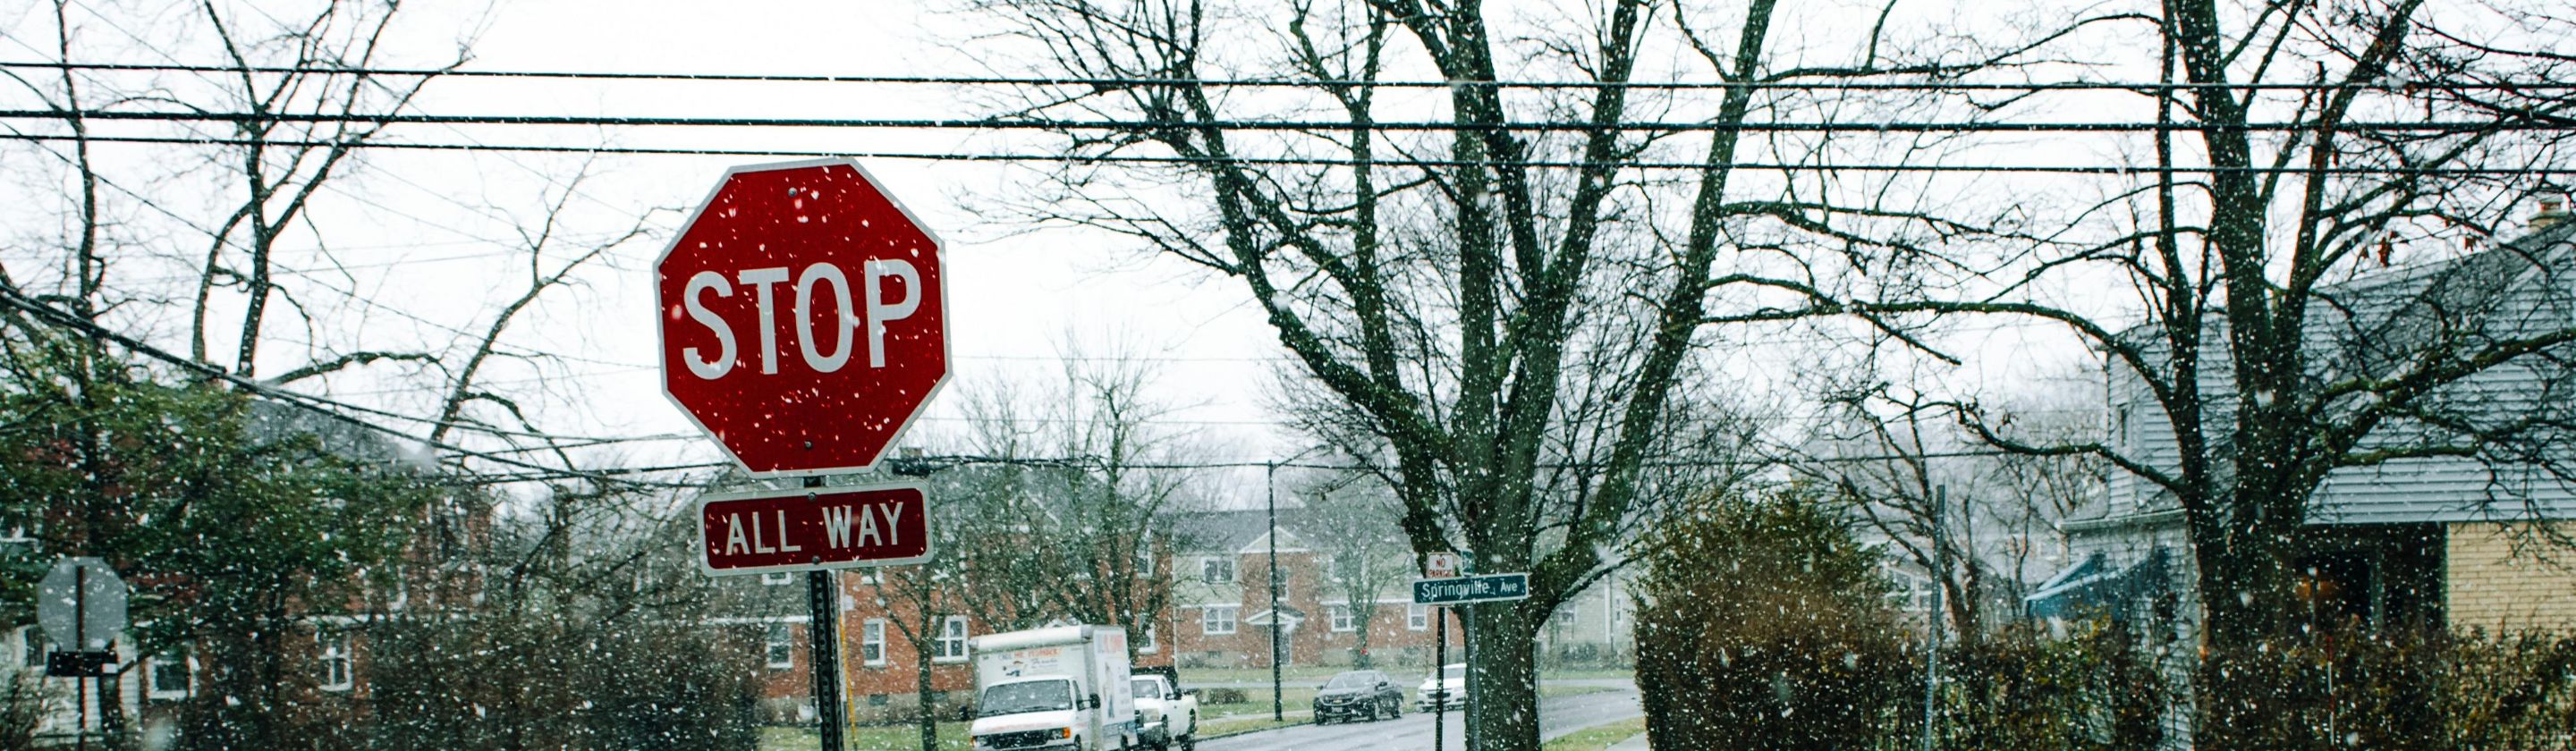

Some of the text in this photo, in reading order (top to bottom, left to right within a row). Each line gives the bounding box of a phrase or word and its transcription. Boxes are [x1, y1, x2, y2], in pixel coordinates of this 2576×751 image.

[683, 258, 921, 380] STOP
[725, 502, 904, 555] ALL WAY
[1436, 557, 1445, 568] NO
[1420, 580, 1518, 602] Springville Ave
